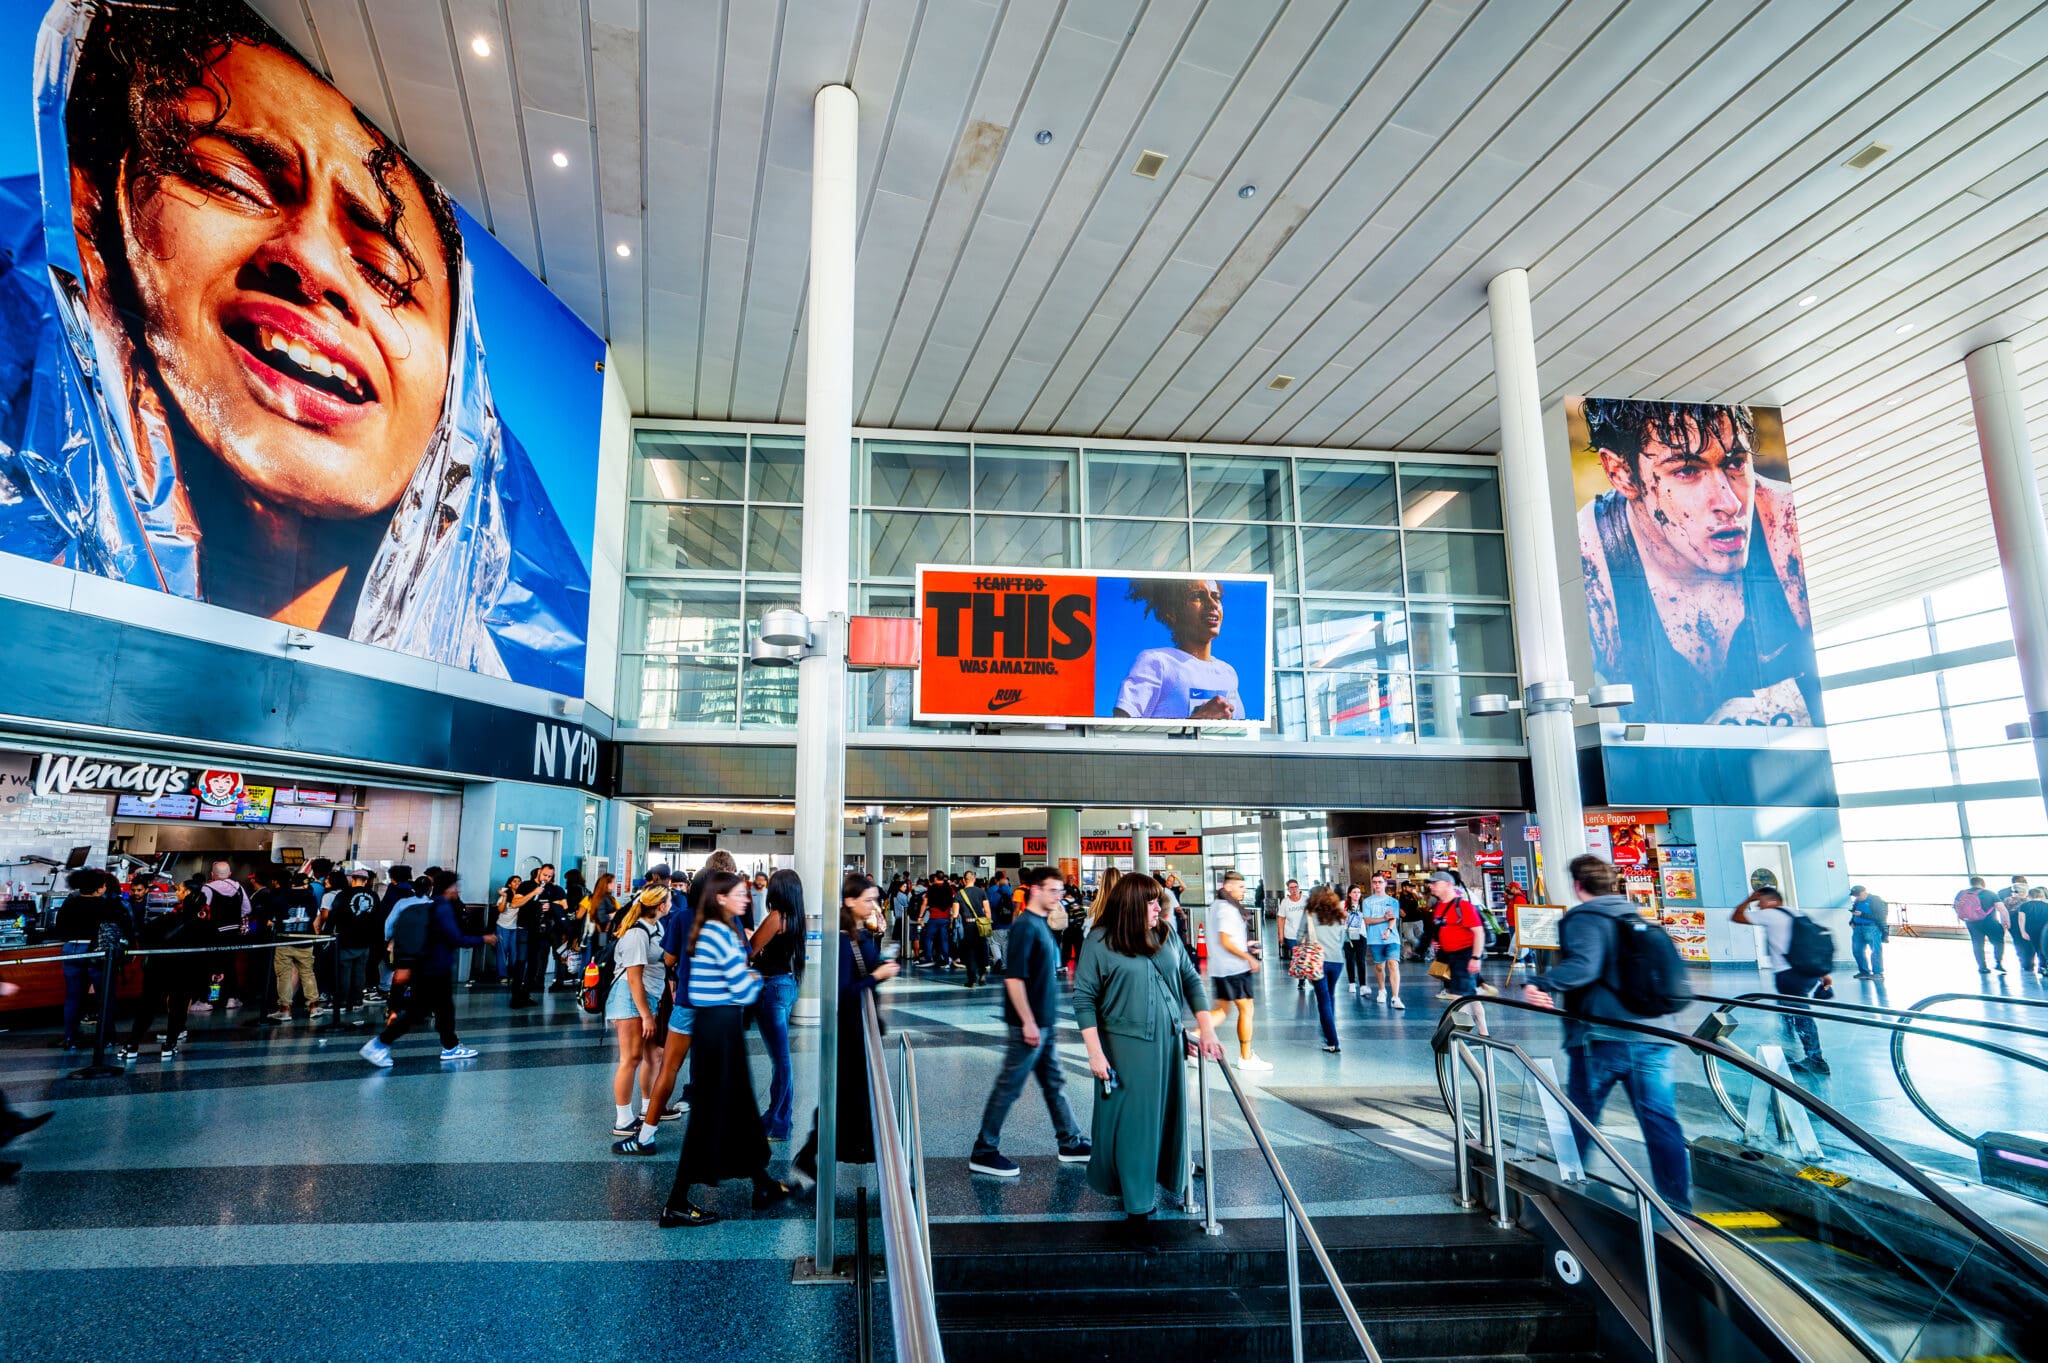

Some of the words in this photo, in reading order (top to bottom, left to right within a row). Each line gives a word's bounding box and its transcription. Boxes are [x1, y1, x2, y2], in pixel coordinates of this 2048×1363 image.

[984, 577, 1023, 591] CAN'T
[1024, 578, 1044, 592] DO
[926, 591, 1092, 660] THIS
[959, 660, 988, 673] WAS
[989, 660, 1059, 675] AMAZING.
[995, 689, 1022, 701] RUN
[533, 722, 598, 785] NYPD
[35, 752, 189, 802] Wendy's
[1585, 814, 1605, 824] Len's
[1607, 813, 1636, 824] Papaya
[1086, 841, 1121, 851] AWFUL
[1155, 841, 1167, 851] IT.
